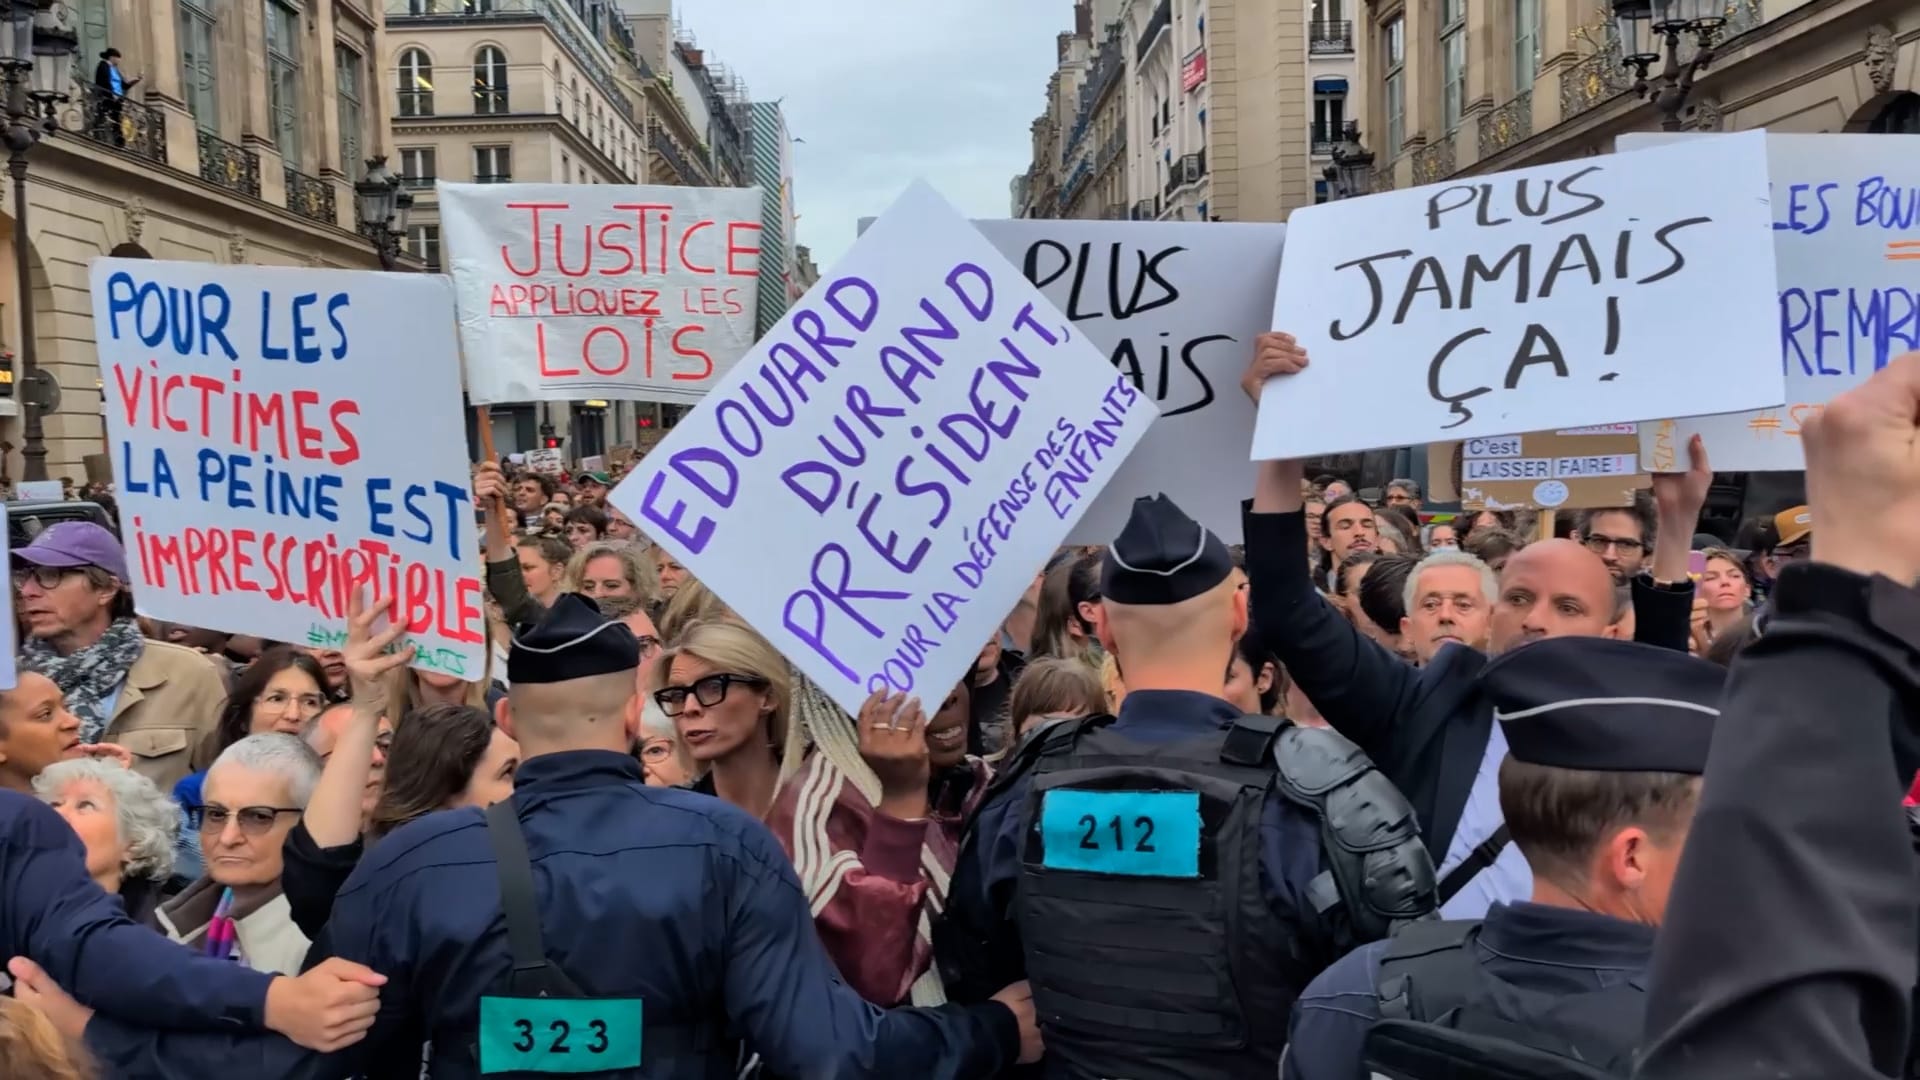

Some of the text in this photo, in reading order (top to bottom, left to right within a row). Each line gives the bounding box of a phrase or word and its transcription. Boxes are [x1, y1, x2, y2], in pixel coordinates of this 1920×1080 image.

[1424, 165, 1604, 230] PLUS
[1855, 176, 1920, 230] BOU
[107, 271, 350, 363] POUR LES
[489, 282, 743, 315] APPLIQUEZ LES
[1023, 239, 1189, 322] PLUS
[1328, 216, 1713, 341] JAMAIS
[536, 317, 715, 380] LOIS
[1778, 287, 1920, 376] REMB
[113, 359, 361, 466] VICTIMES
[640, 276, 879, 555] EDOUARD
[781, 262, 994, 515] DURAND
[1044, 375, 1137, 520] ENFANTS
[1468, 460, 1549, 479] LAISSER
[1469, 440, 1518, 455] C'est
[123, 441, 470, 561] LA PEINE EST
[867, 416, 1076, 703] POUR LA DÉFENSE DES
[1078, 814, 1156, 853] 212
[512, 1018, 609, 1054] 323
